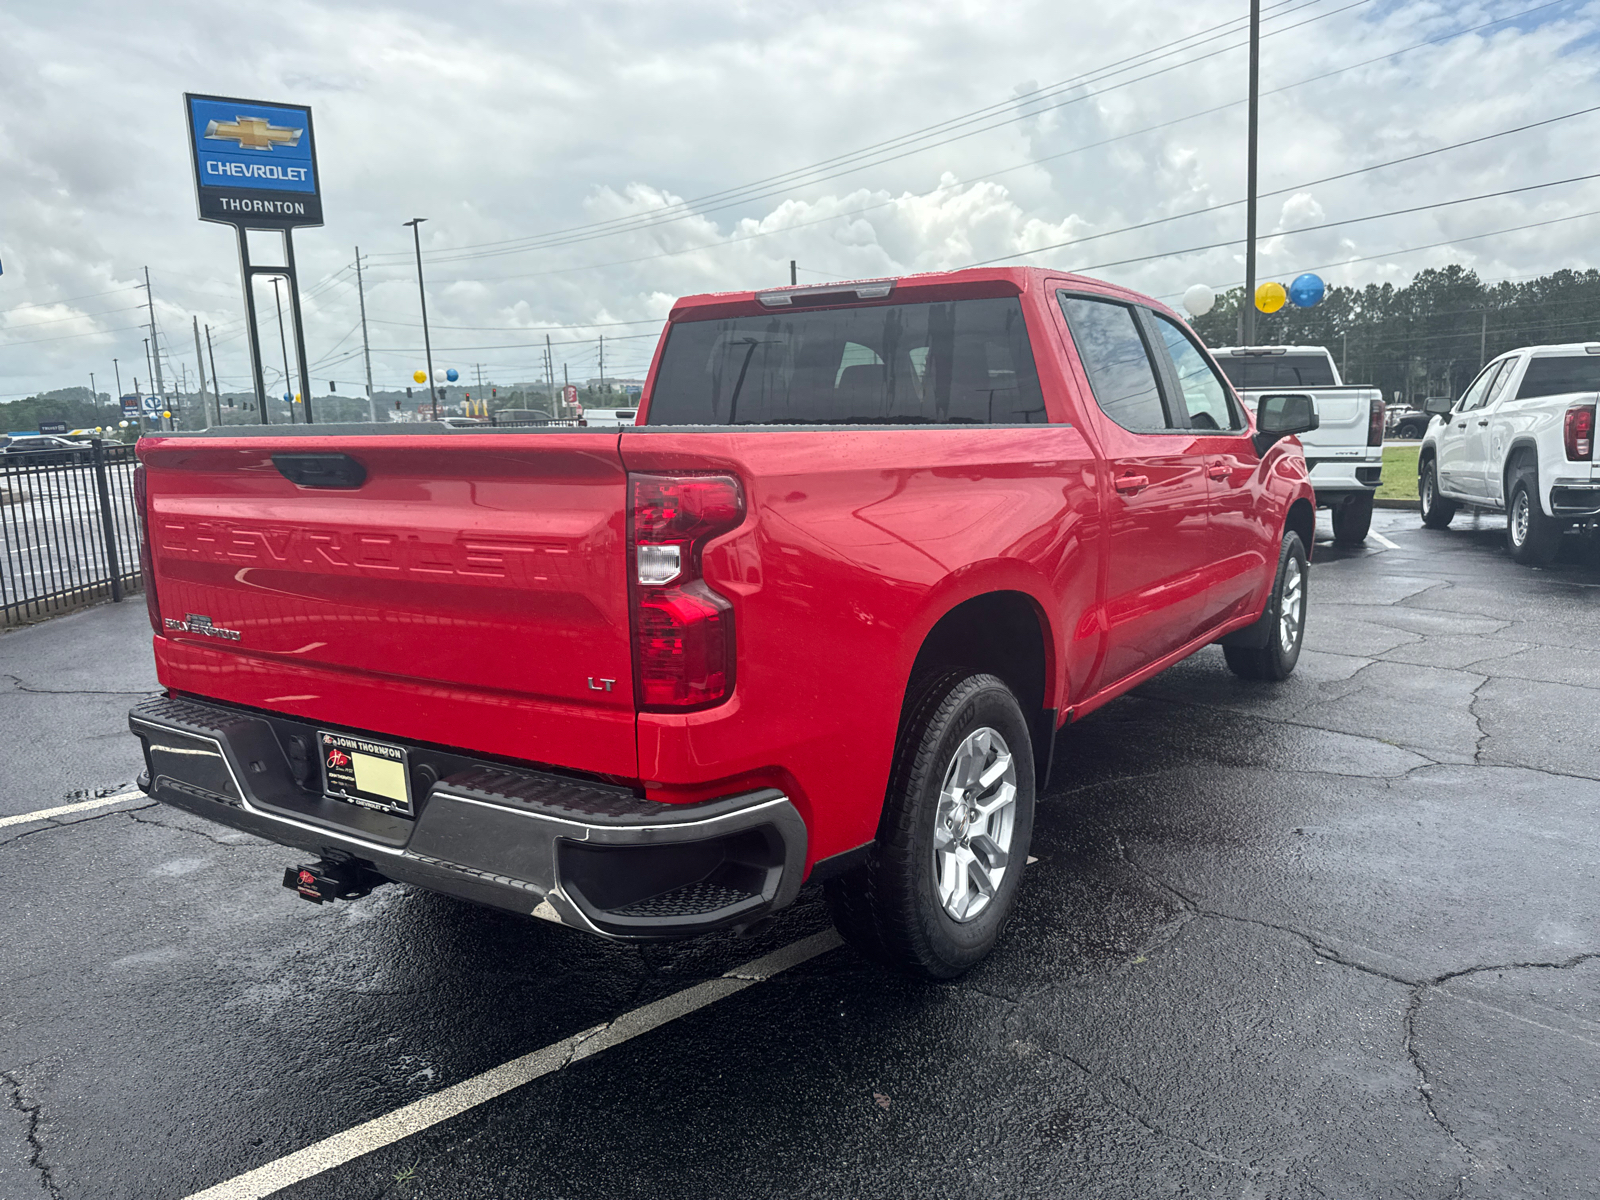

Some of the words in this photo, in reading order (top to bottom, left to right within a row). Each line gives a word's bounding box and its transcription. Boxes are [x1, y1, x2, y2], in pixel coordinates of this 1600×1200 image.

[206, 161, 307, 181] CHEVROLET
[220, 198, 305, 215] THORNTON
[162, 521, 570, 582] CHEVROLET
[164, 617, 241, 641] SILVERADO
[587, 676, 616, 692] LT
[336, 737, 358, 749] JOHN
[358, 742, 402, 759] THORNTON
[355, 799, 382, 810] CHEVROLET
